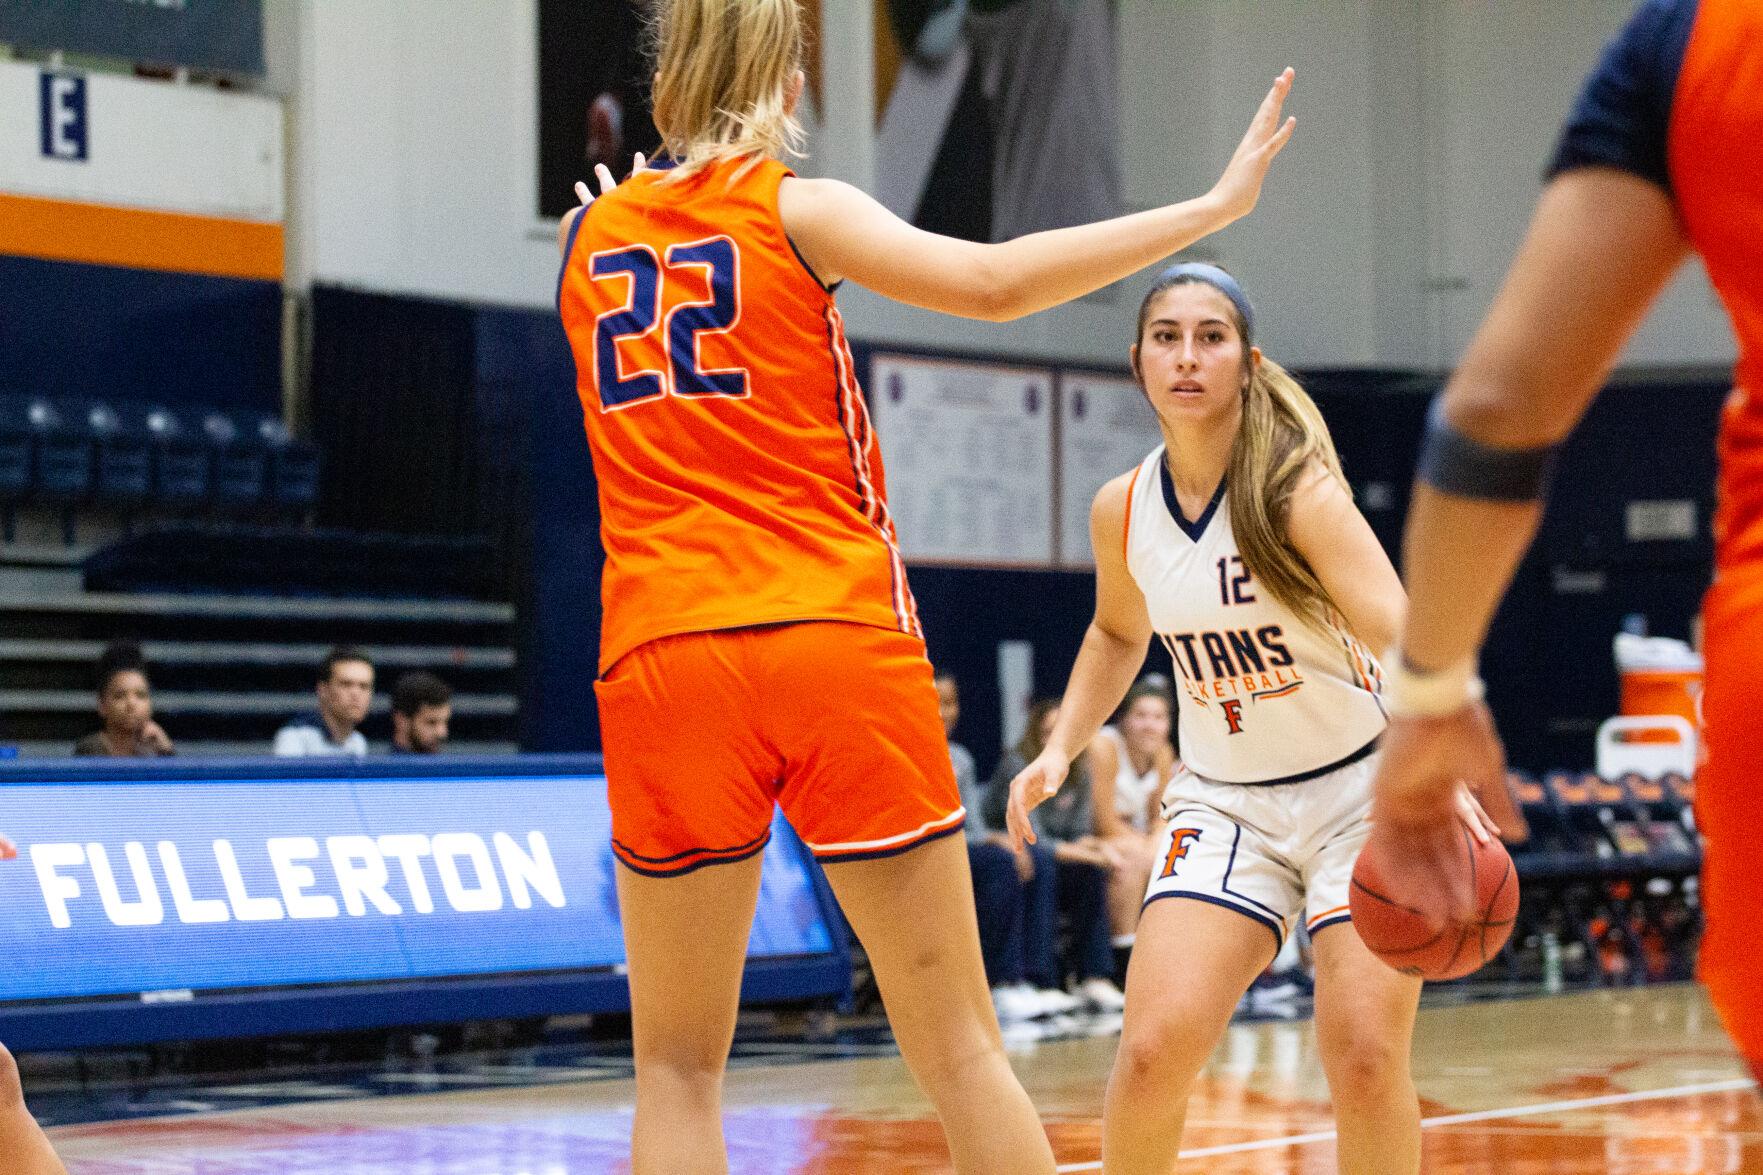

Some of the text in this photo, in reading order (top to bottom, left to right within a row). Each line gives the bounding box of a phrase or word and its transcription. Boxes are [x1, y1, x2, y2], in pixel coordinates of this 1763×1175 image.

[52, 78, 80, 156] E
[588, 234, 752, 415] 22
[1216, 556, 1256, 605] 12
[1164, 624, 1295, 682] ITANS
[1185, 668, 1303, 699] KETBALL
[1219, 698, 1244, 735] F
[29, 830, 567, 928] FULLERTON
[1157, 828, 1203, 881] F
